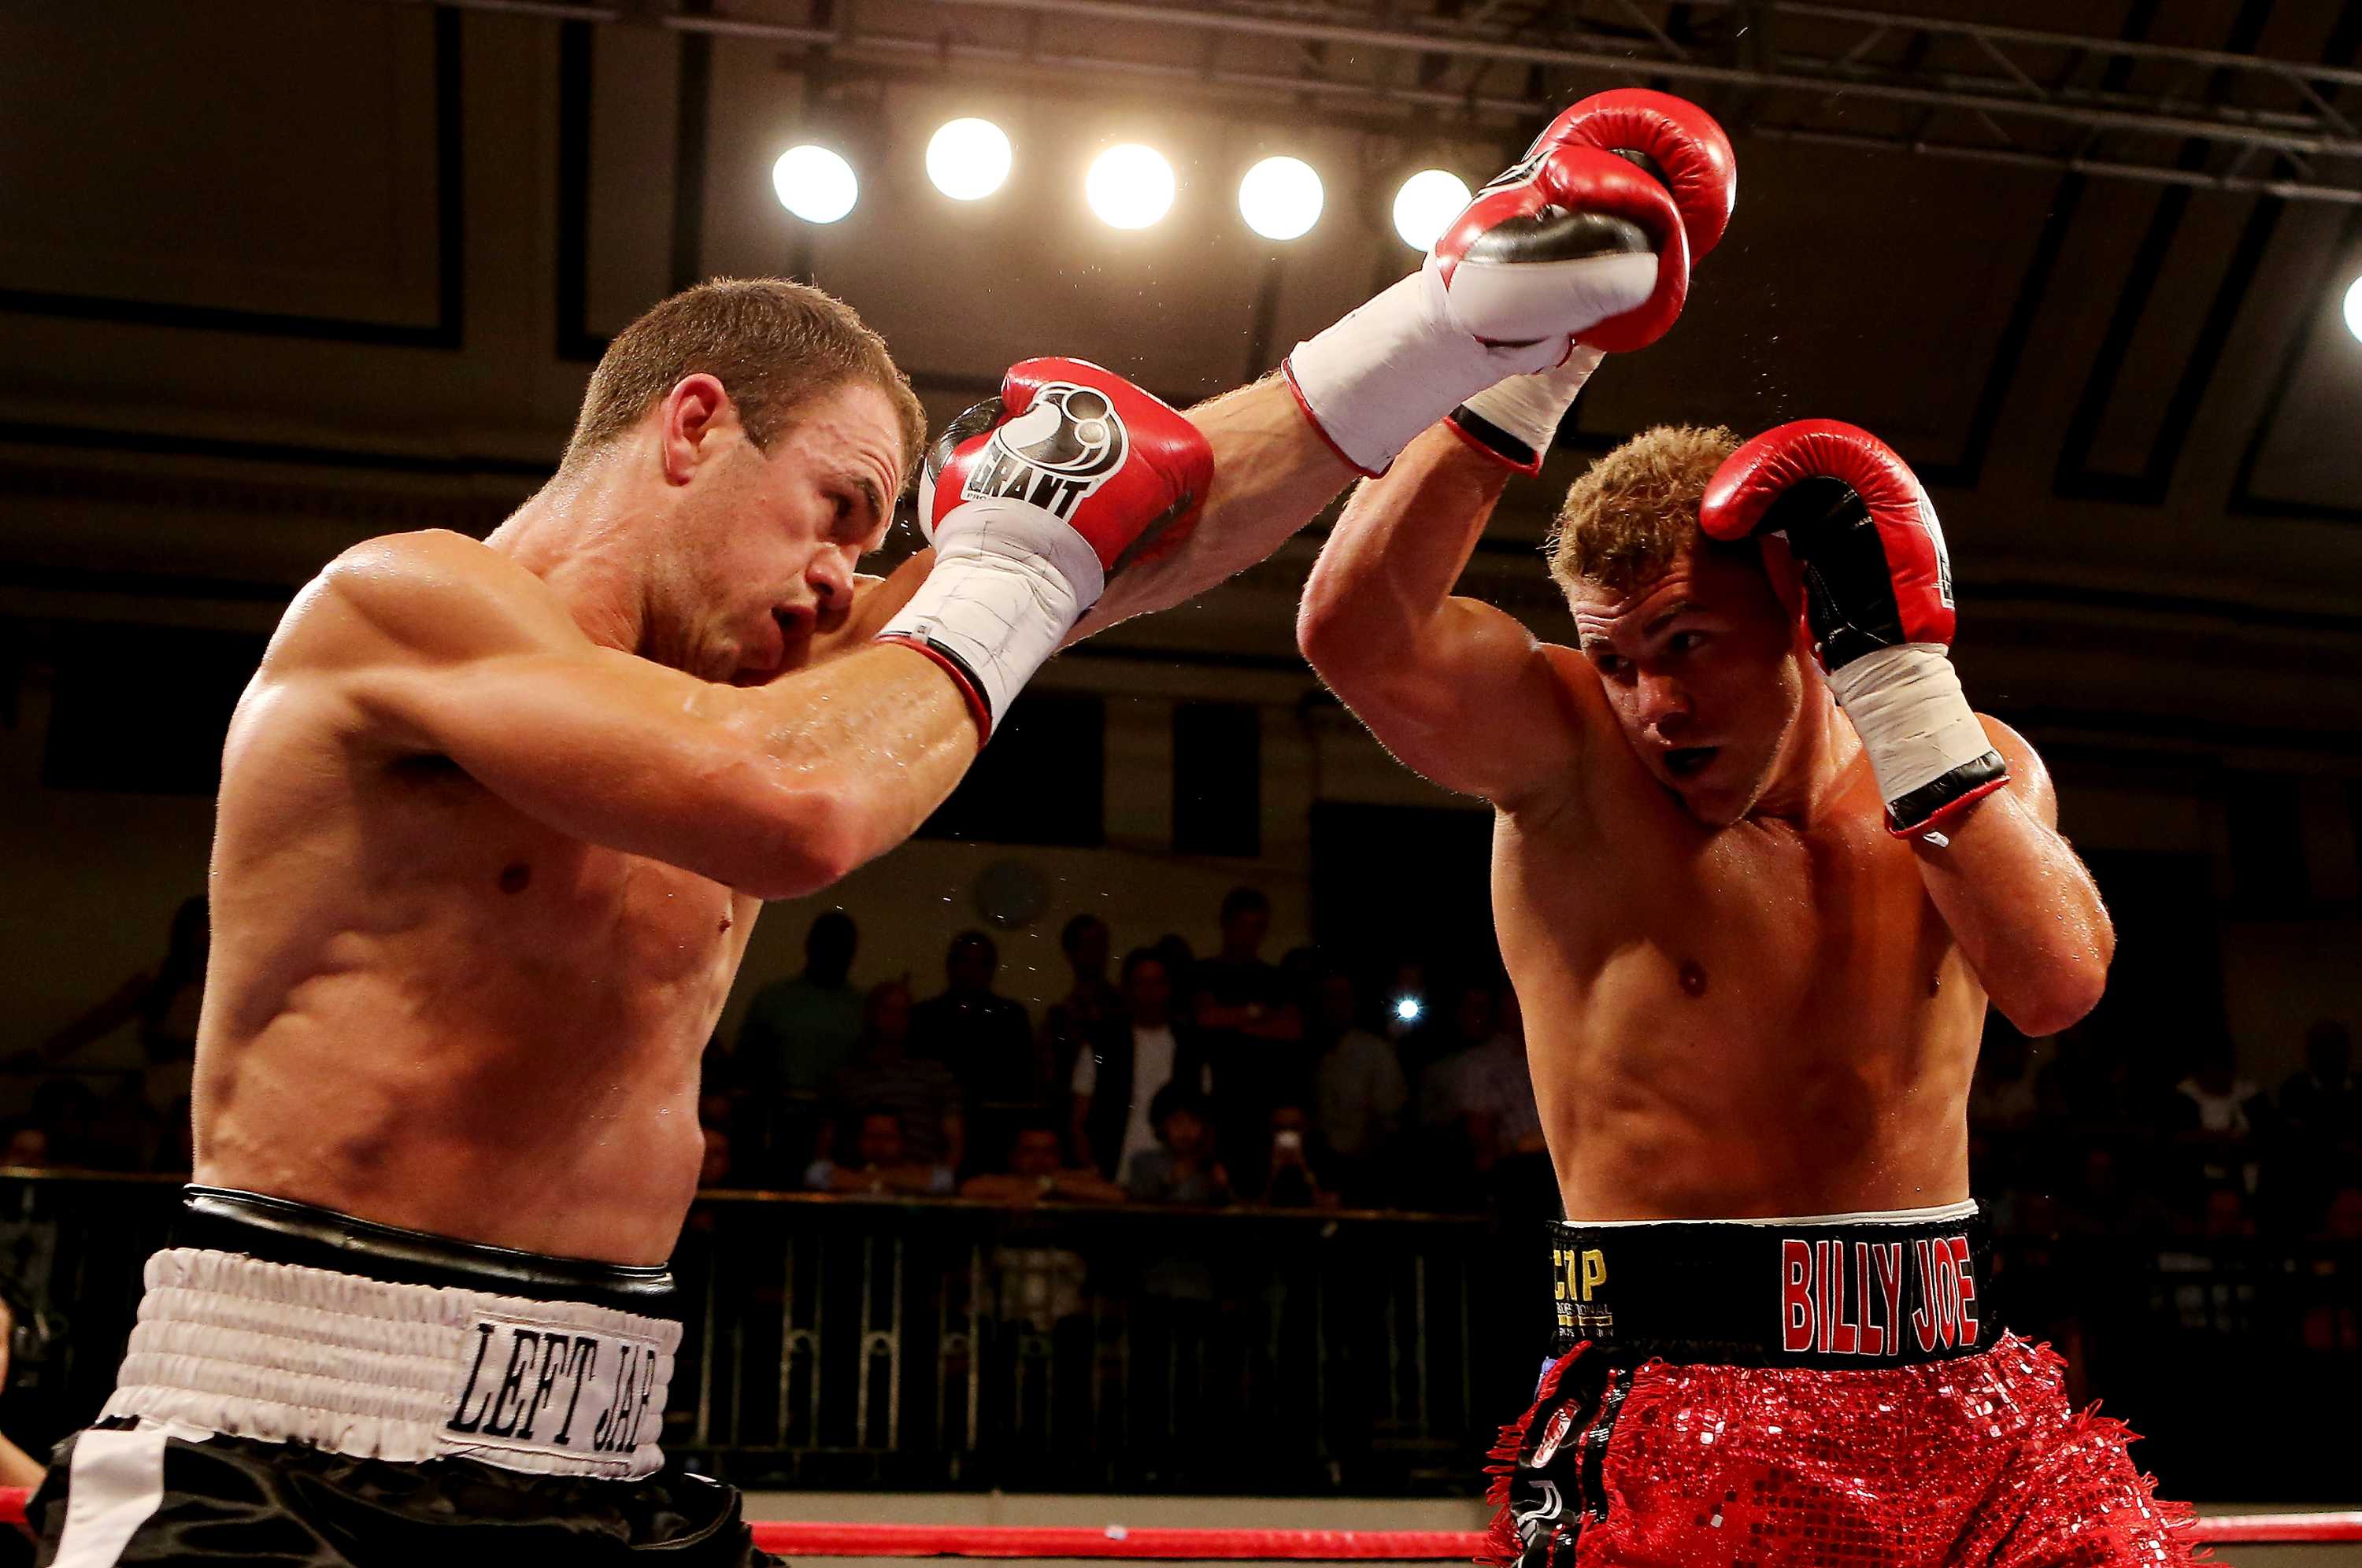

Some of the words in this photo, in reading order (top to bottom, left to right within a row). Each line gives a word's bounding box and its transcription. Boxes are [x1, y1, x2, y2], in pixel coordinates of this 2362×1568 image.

[968, 440, 1092, 520] GRANT
[1782, 1238, 1901, 1356] BILLY
[1912, 1236, 1979, 1353] JOE
[447, 1322, 598, 1445] LEFT
